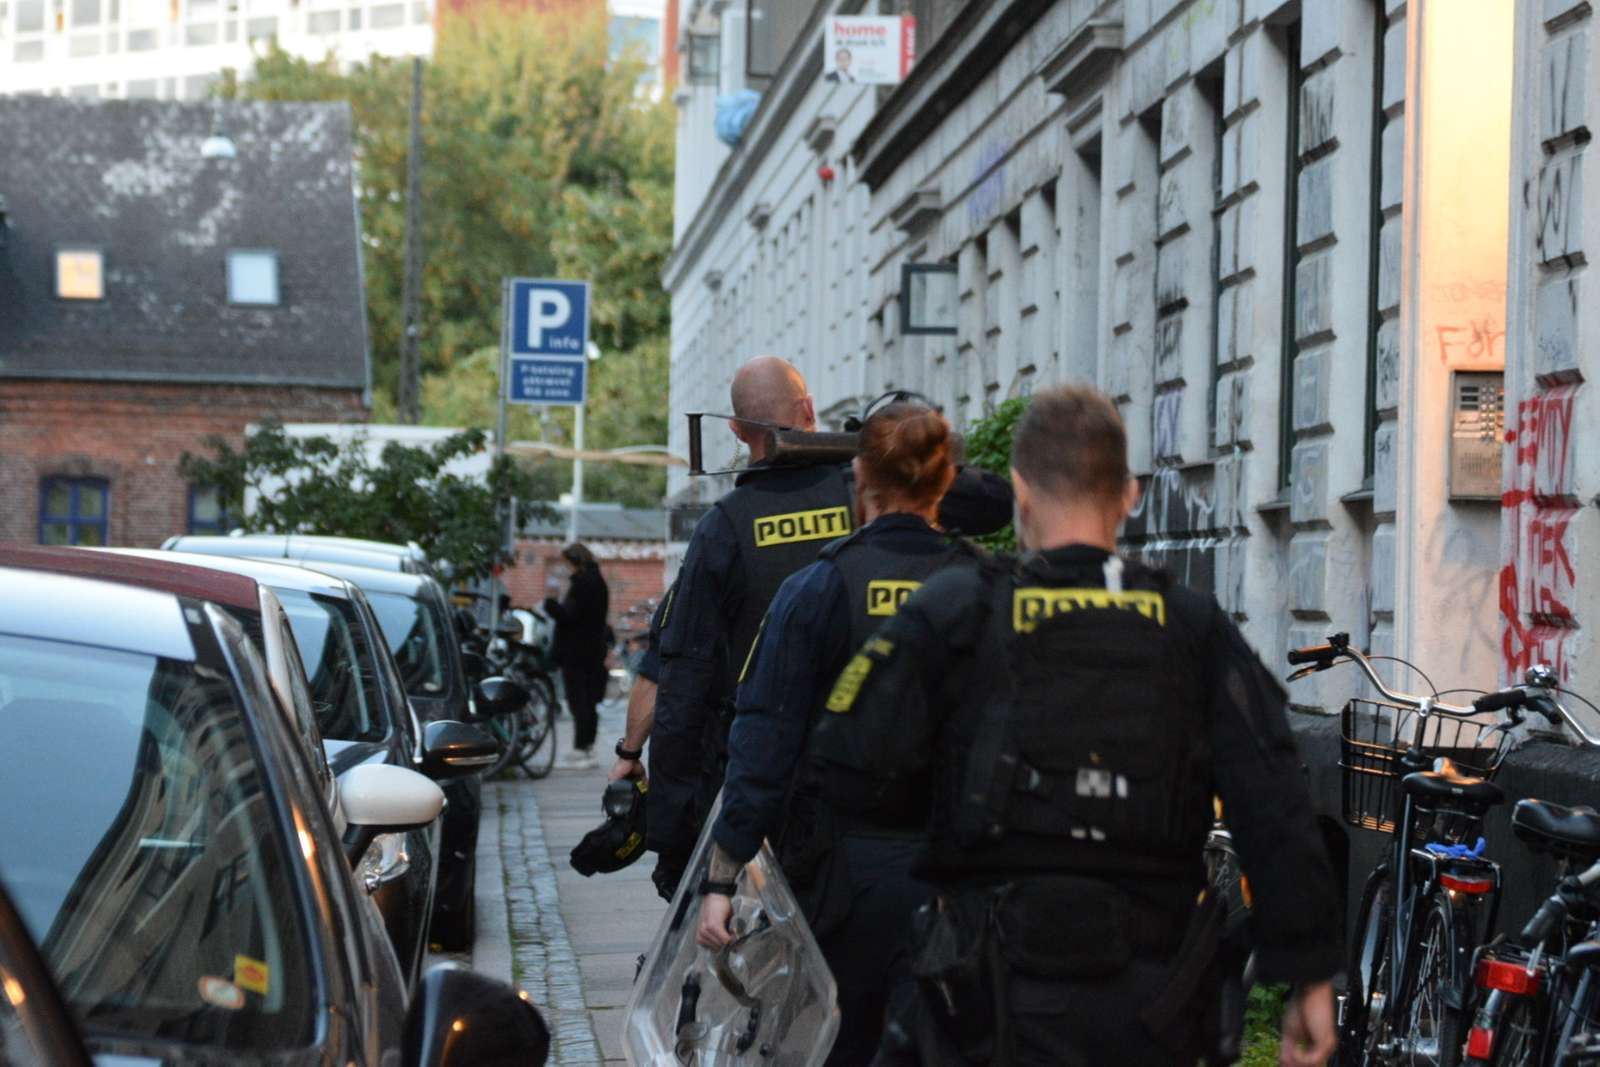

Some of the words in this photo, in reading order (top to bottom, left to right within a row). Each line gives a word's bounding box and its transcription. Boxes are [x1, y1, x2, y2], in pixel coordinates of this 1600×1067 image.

[833, 21, 888, 36] home
[527, 288, 571, 349] P
[548, 336, 580, 350] info
[757, 511, 848, 542] POLITI
